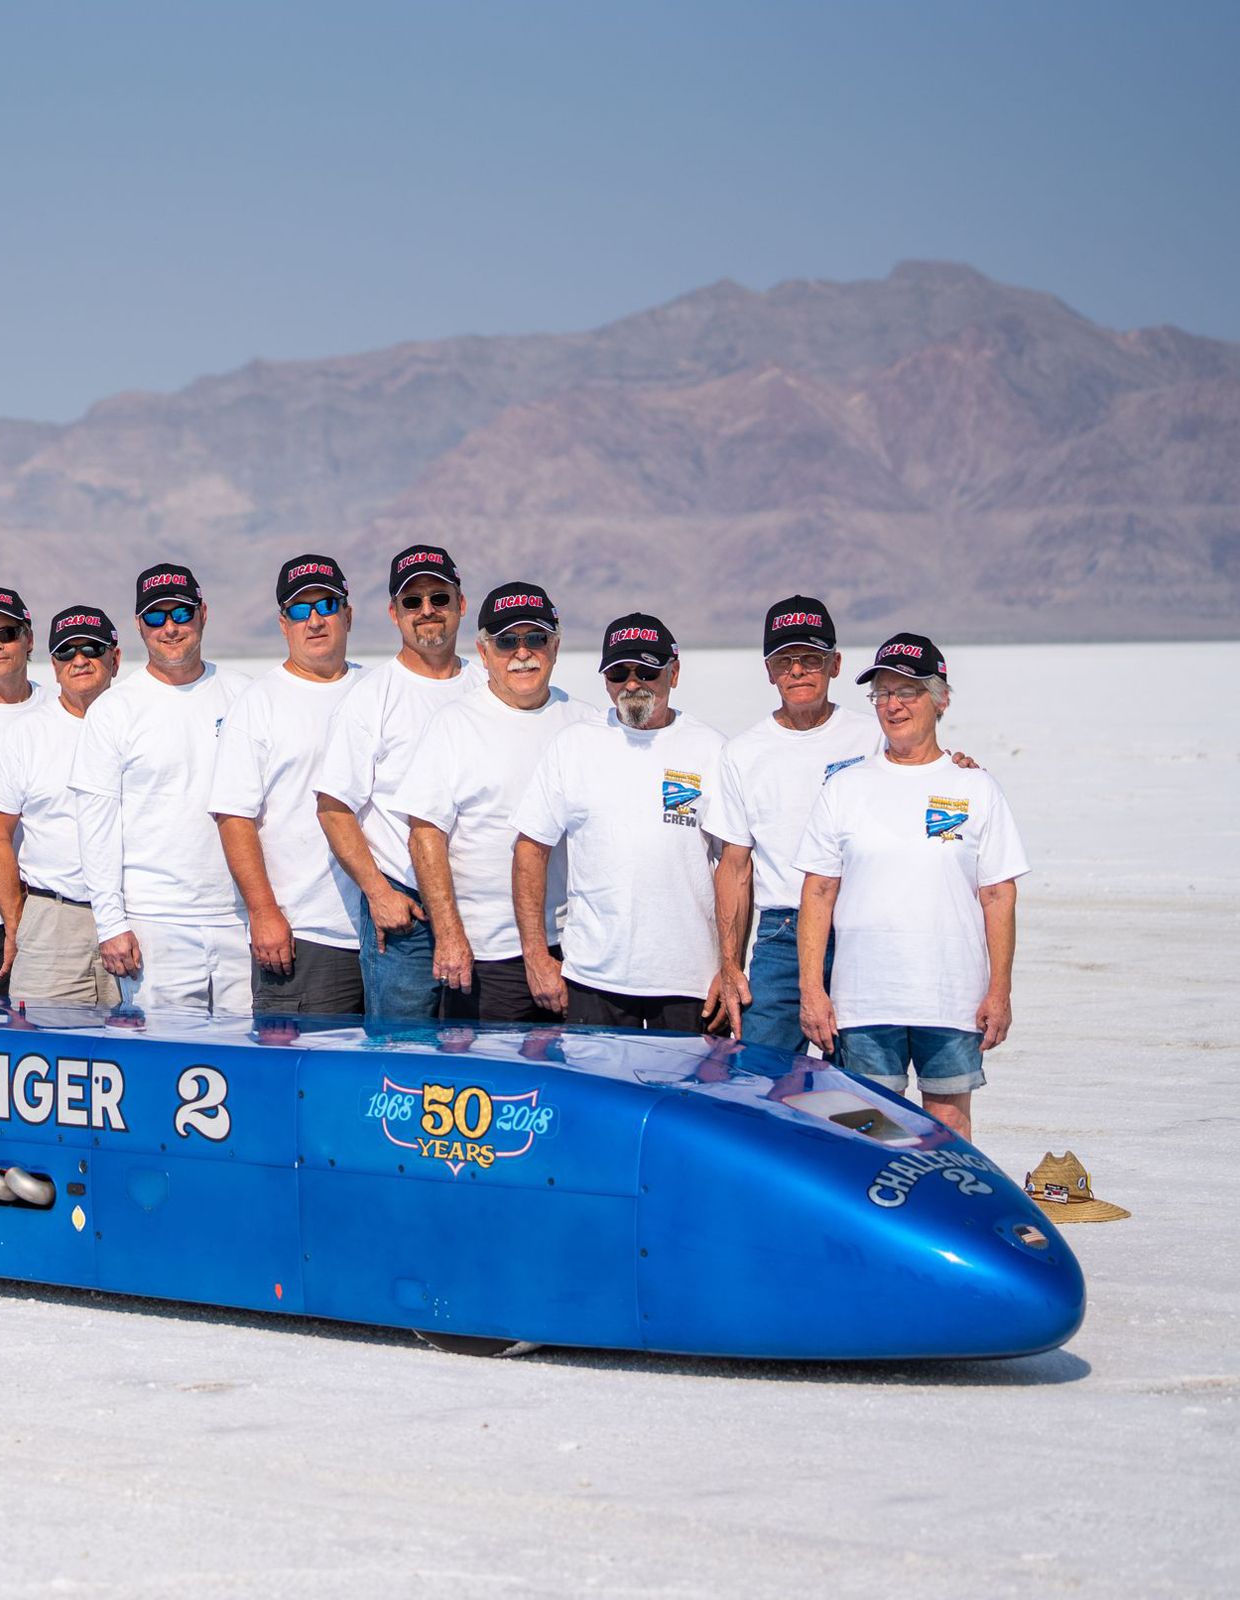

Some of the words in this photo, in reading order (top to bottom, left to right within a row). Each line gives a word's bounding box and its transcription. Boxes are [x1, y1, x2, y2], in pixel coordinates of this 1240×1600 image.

[398, 552, 427, 573] LUCAS
[427, 553, 443, 564] OIL
[288, 563, 318, 583] LUCAS
[318, 565, 334, 576] OIL
[142, 574, 172, 592] LUCAS
[172, 575, 188, 586] OIL
[494, 594, 528, 612] LUCAS
[528, 595, 544, 607] OIL
[56, 615, 85, 631] LUCAS
[85, 615, 101, 626] OIL
[772, 612, 806, 631] LUCAS
[806, 613, 822, 627] OIL
[609, 629, 639, 647] LUCAS
[639, 628, 659, 641] OIL
[903, 645, 923, 659] OIL
[663, 813, 697, 828] CREW
[174, 1064, 233, 1142] 2
[365, 1092, 415, 1122] 1968
[420, 1083, 493, 1140] 50
[496, 1103, 554, 1135] 2018
[415, 1136, 496, 1169] YEARS
